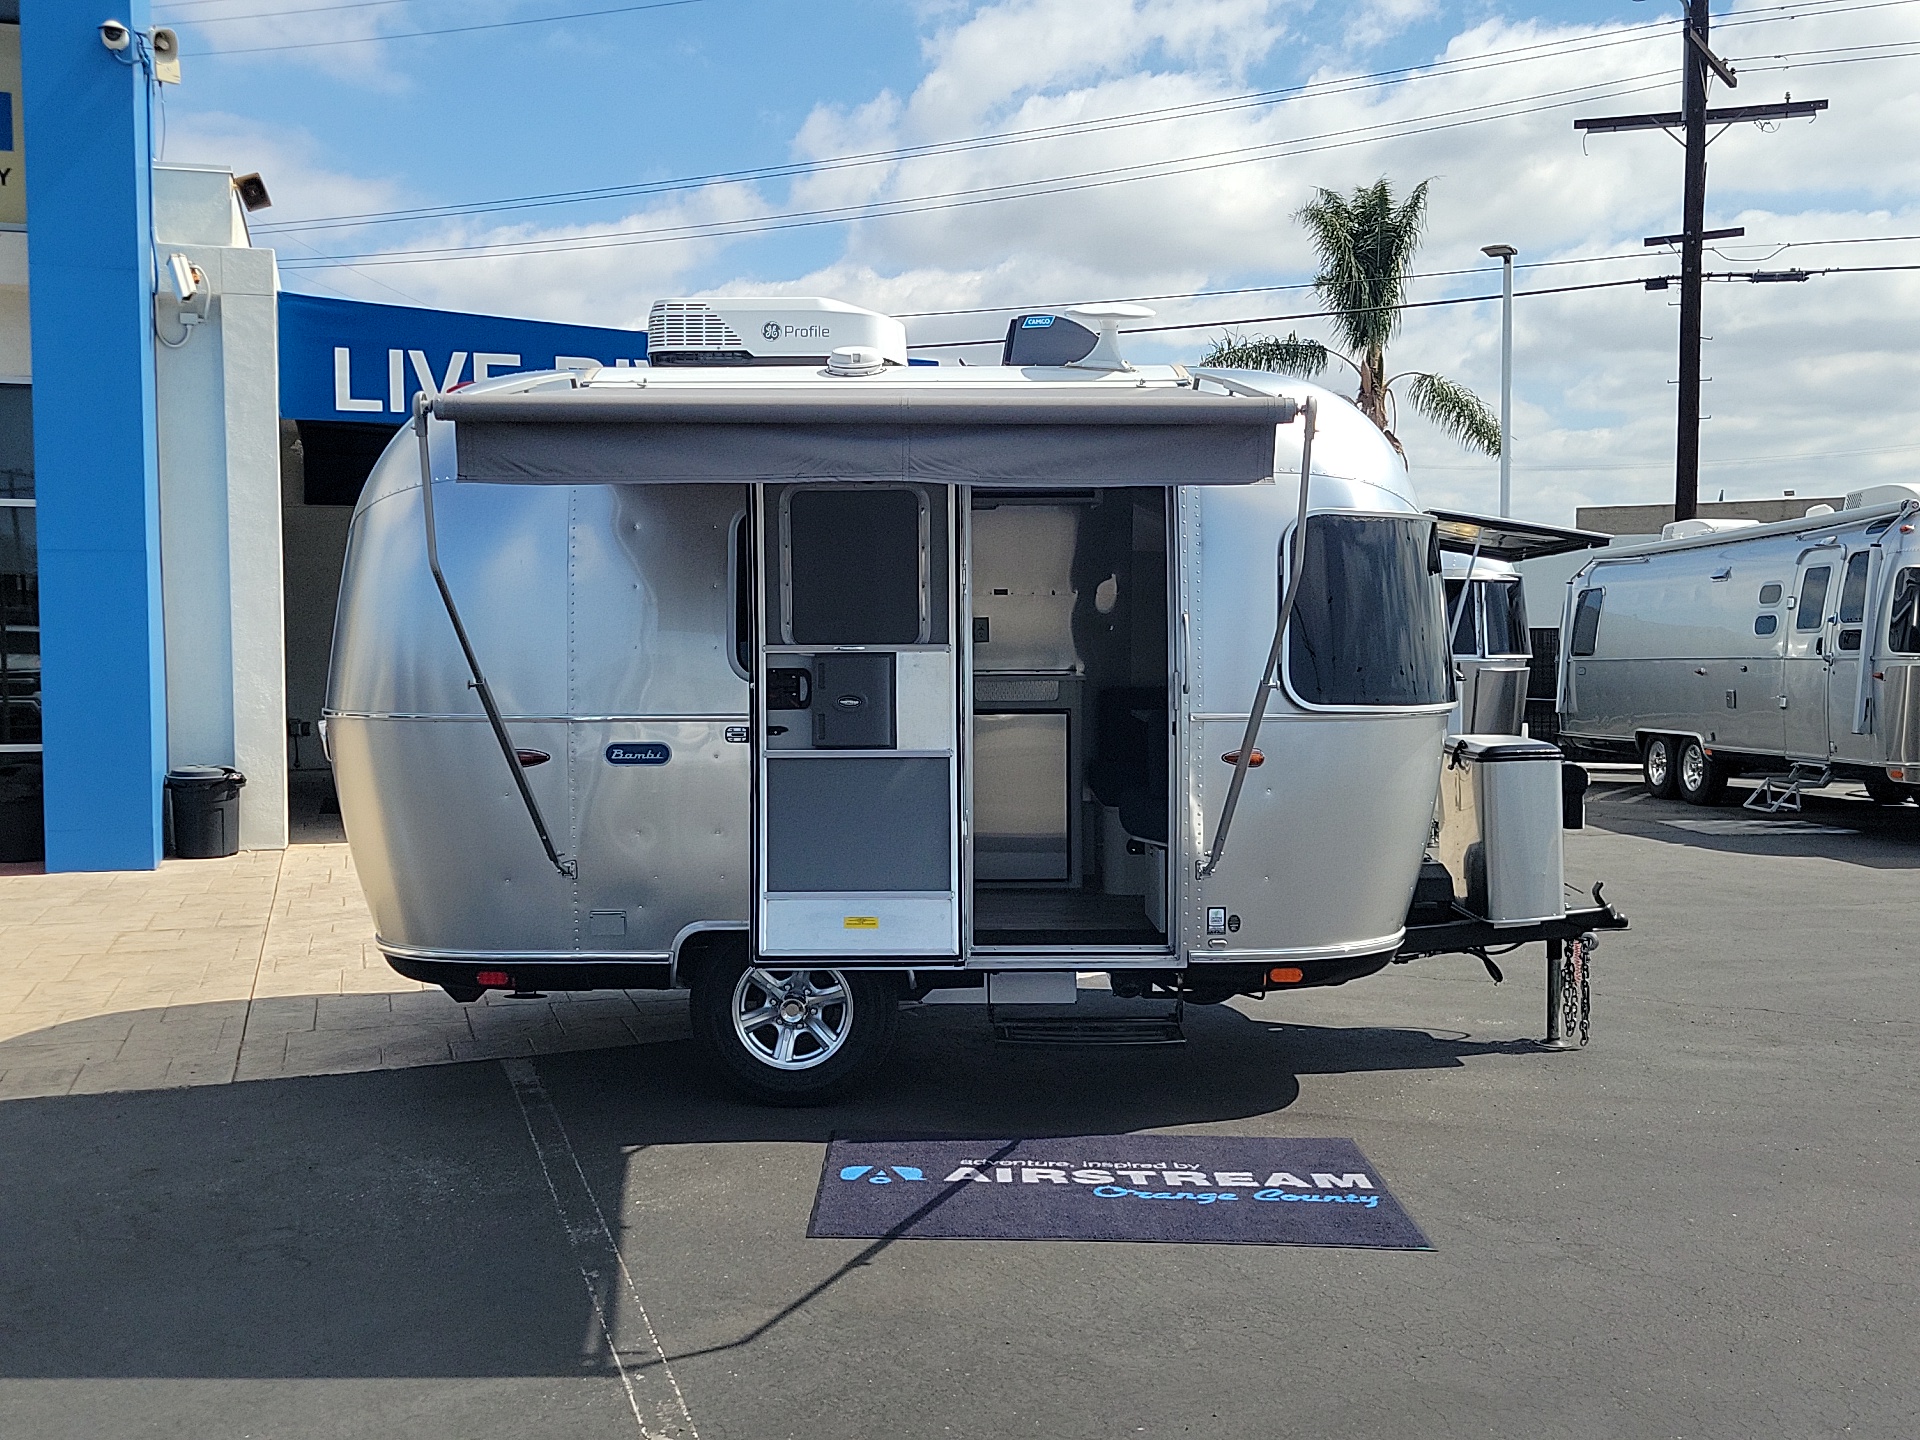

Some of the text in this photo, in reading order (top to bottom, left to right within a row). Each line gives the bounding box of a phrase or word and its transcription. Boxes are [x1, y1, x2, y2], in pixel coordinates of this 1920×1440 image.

[1027, 318, 1051, 326] CAMCO
[784, 325, 830, 338] Profile
[611, 749, 664, 760] Bambi
[1082, 1161, 1168, 1170] inspired
[1173, 1162, 1200, 1170] by
[943, 1167, 1374, 1189] AIRSTREAM
[1093, 1186, 1380, 1208] Orange County
